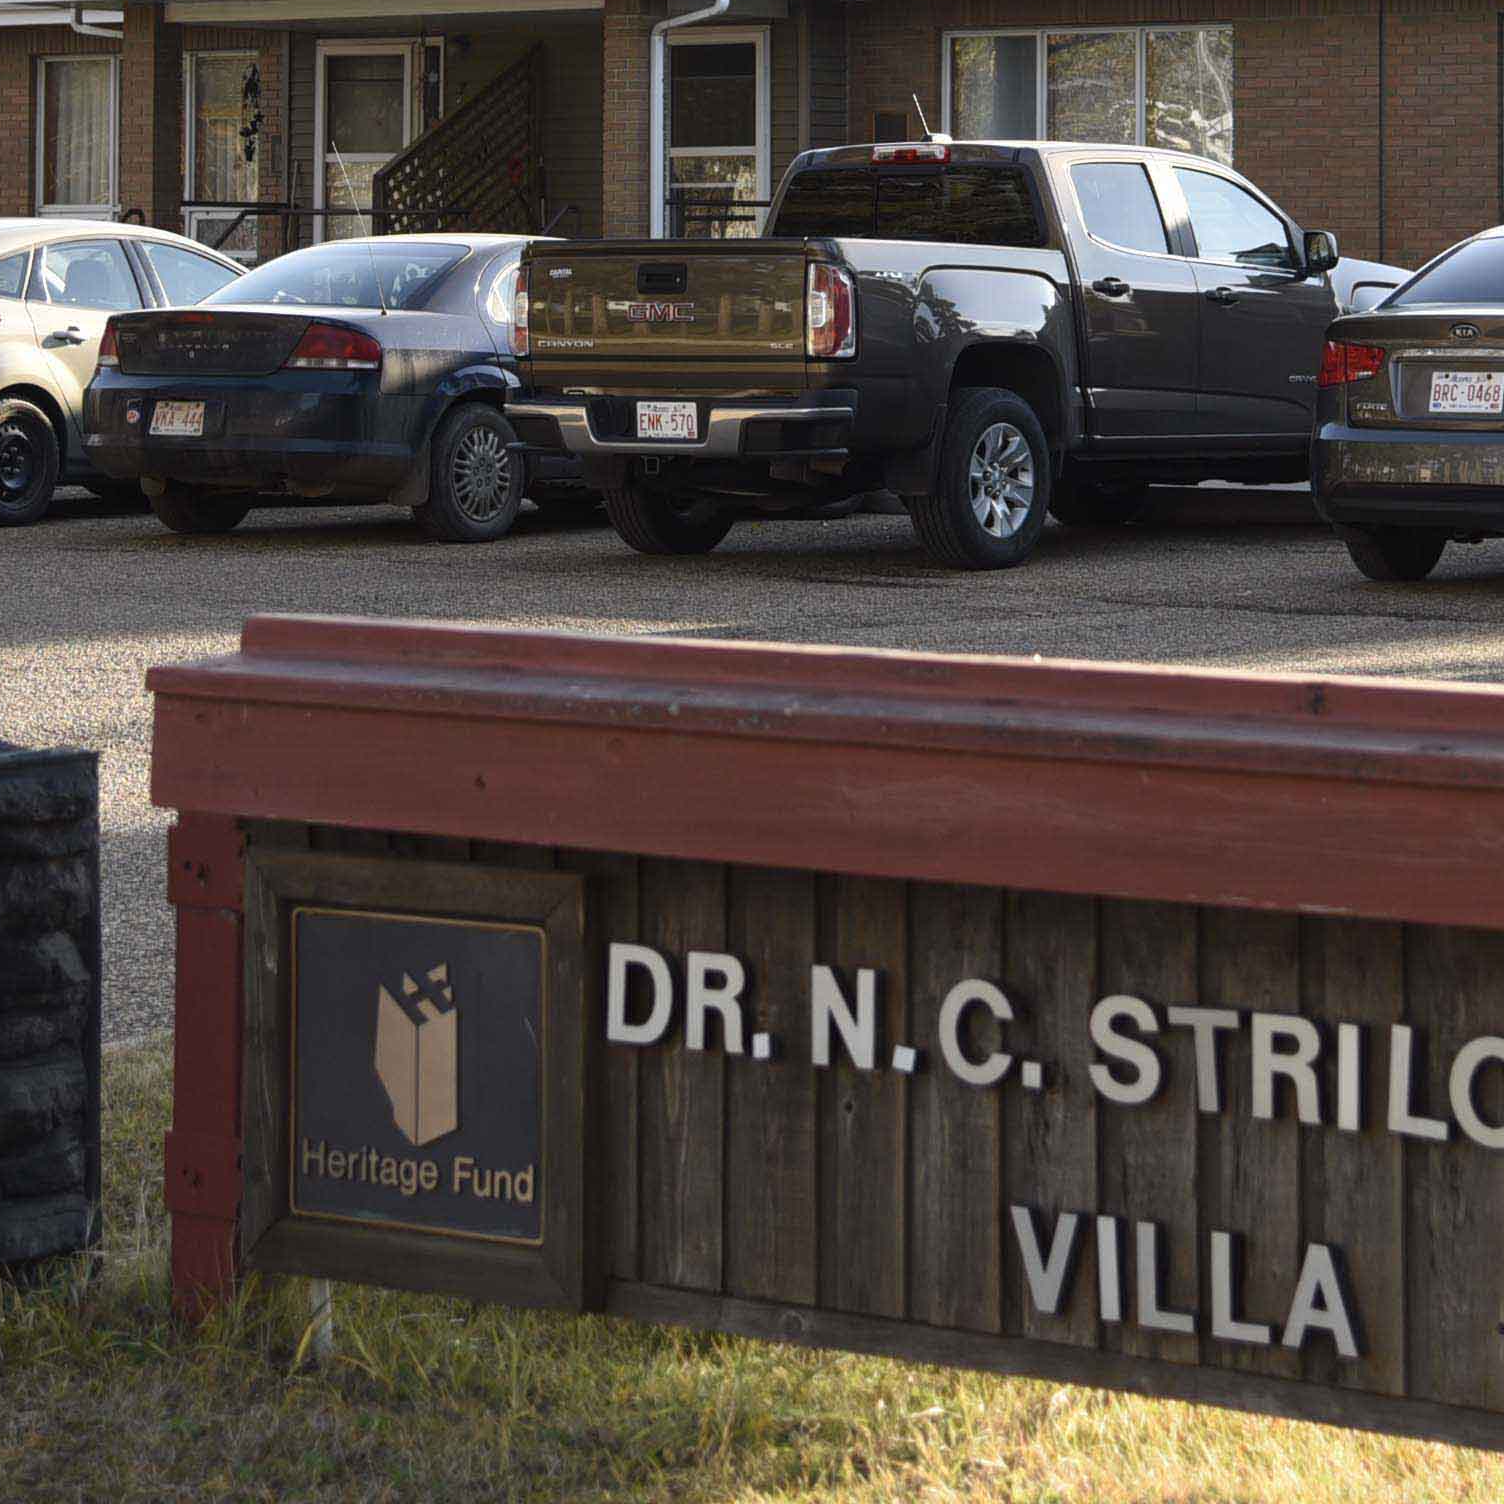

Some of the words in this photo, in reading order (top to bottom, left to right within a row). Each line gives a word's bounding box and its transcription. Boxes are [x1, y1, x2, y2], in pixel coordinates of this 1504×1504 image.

[627, 302, 695, 322] GMC
[1455, 328, 1473, 337] KIA
[1433, 383, 1502, 402] BRC-0468
[639, 413, 695, 432] ENK-570
[607, 942, 771, 1060] DR.
[301, 1138, 439, 1195] Heritage
[452, 1155, 535, 1204] Fund
[1009, 1205, 1360, 1359] VILLA
